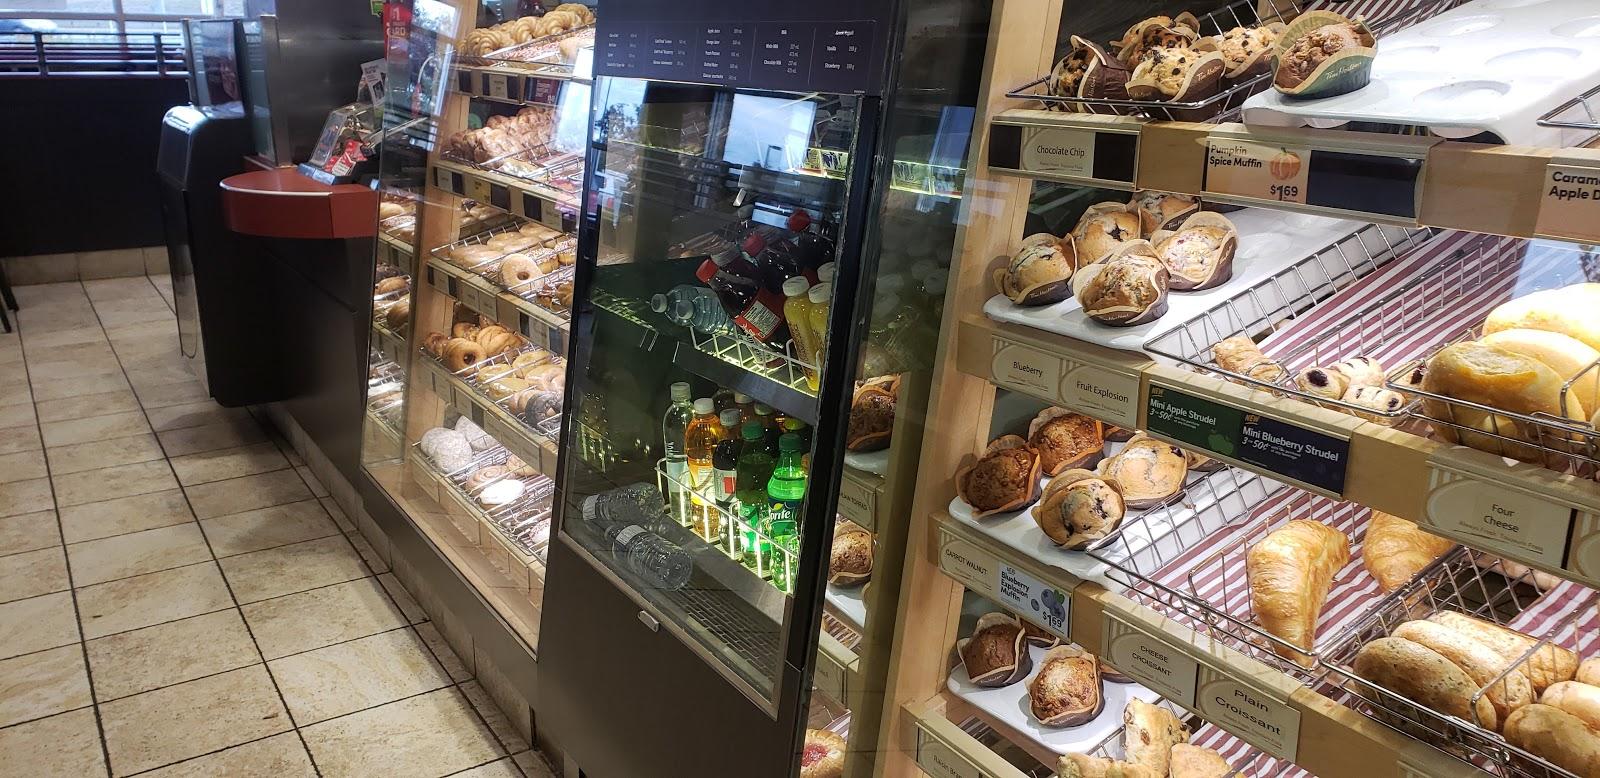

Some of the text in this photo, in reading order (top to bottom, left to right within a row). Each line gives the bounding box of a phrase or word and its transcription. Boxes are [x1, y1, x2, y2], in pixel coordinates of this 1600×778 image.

[1036, 144, 1085, 158] Chocolate Chip
[1210, 144, 1247, 156] Pumpkin
[1209, 155, 1263, 169] Spice Muffin
[1552, 171, 1600, 186] Caram
[1549, 185, 1590, 201] Apple
[1013, 361, 1043, 378] Blueberry
[1076, 380, 1129, 404] Fruit Explosion
[1150, 399, 1217, 426] Mini Apple Strudel
[1242, 425, 1339, 462] Mini Blueberry Strudel
[1491, 503, 1515, 518] Four
[1483, 515, 1520, 533] Cheese
[945, 549, 988, 576] CARROT WALNUT
[1000, 578, 1029, 600] Explosion
[1001, 571, 1030, 592] Blueberry
[1000, 586, 1021, 603] Muffin
[1140, 645, 1169, 663] CHEESE
[1131, 652, 1172, 677] CROISSANT
[1234, 689, 1269, 713] Plain
[1215, 696, 1281, 736] Croissant
